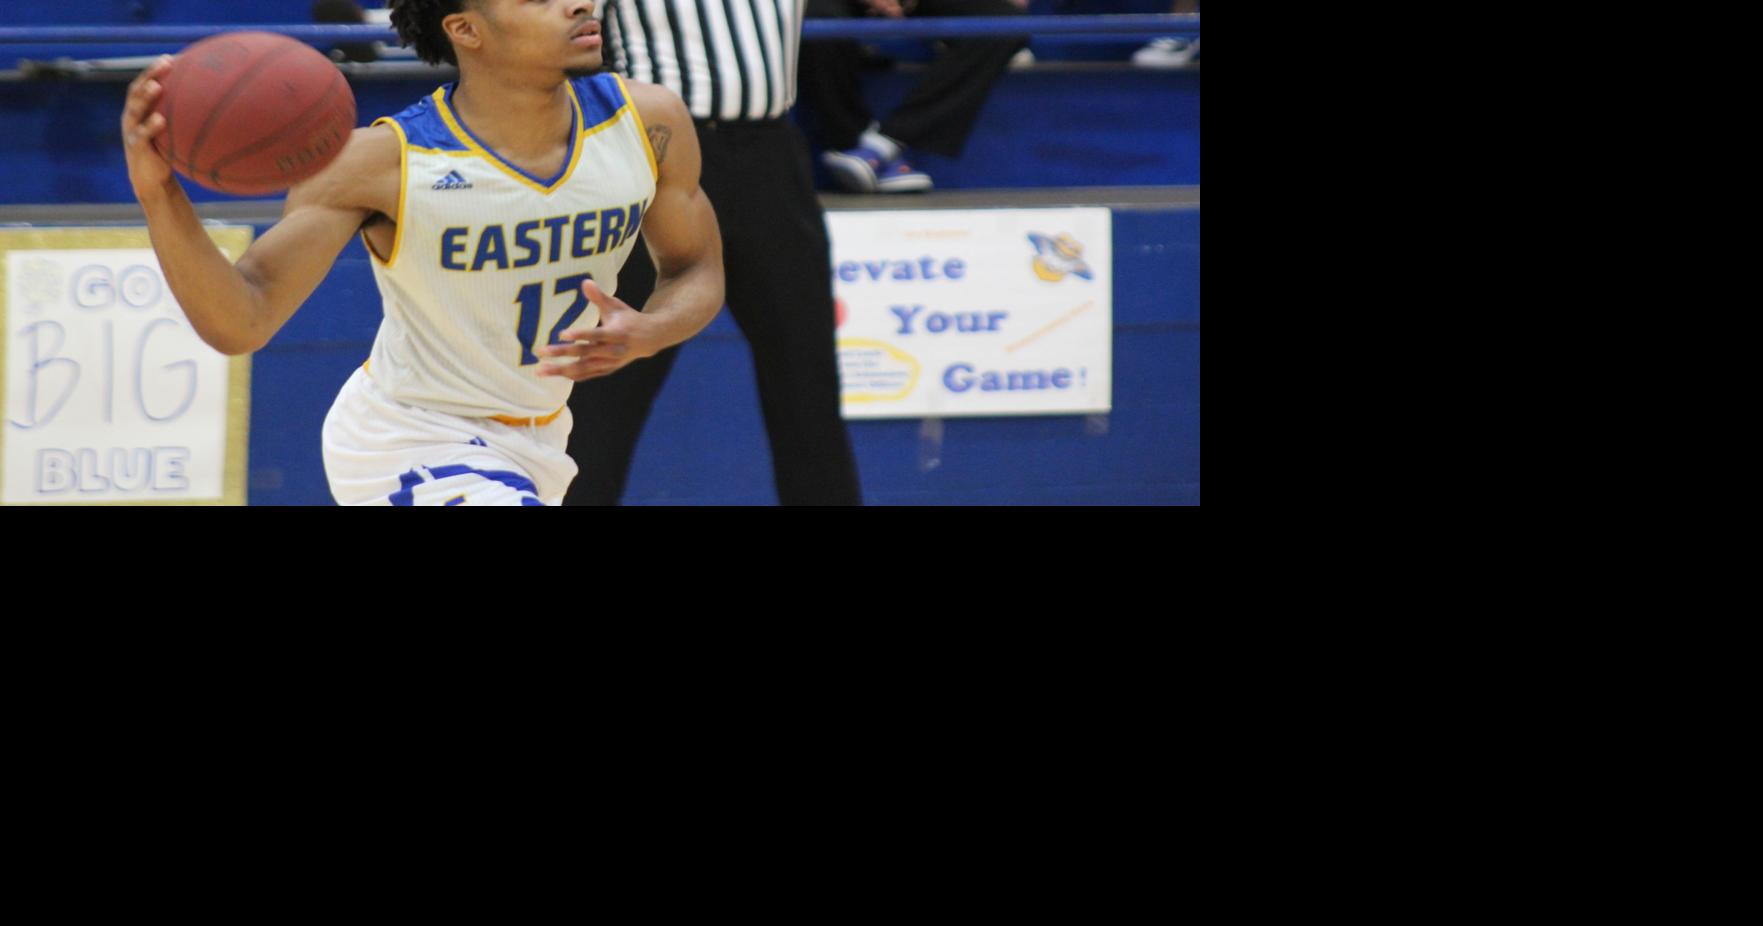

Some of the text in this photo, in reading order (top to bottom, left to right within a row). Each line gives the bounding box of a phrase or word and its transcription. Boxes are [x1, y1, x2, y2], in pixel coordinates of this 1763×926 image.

[432, 182, 472, 190] adidas
[440, 197, 649, 271] EASTERN
[72, 263, 162, 309] GO
[513, 272, 594, 366] 12
[890, 304, 1008, 335] Your
[10, 316, 198, 429] BIG
[36, 447, 190, 494] BLUE
